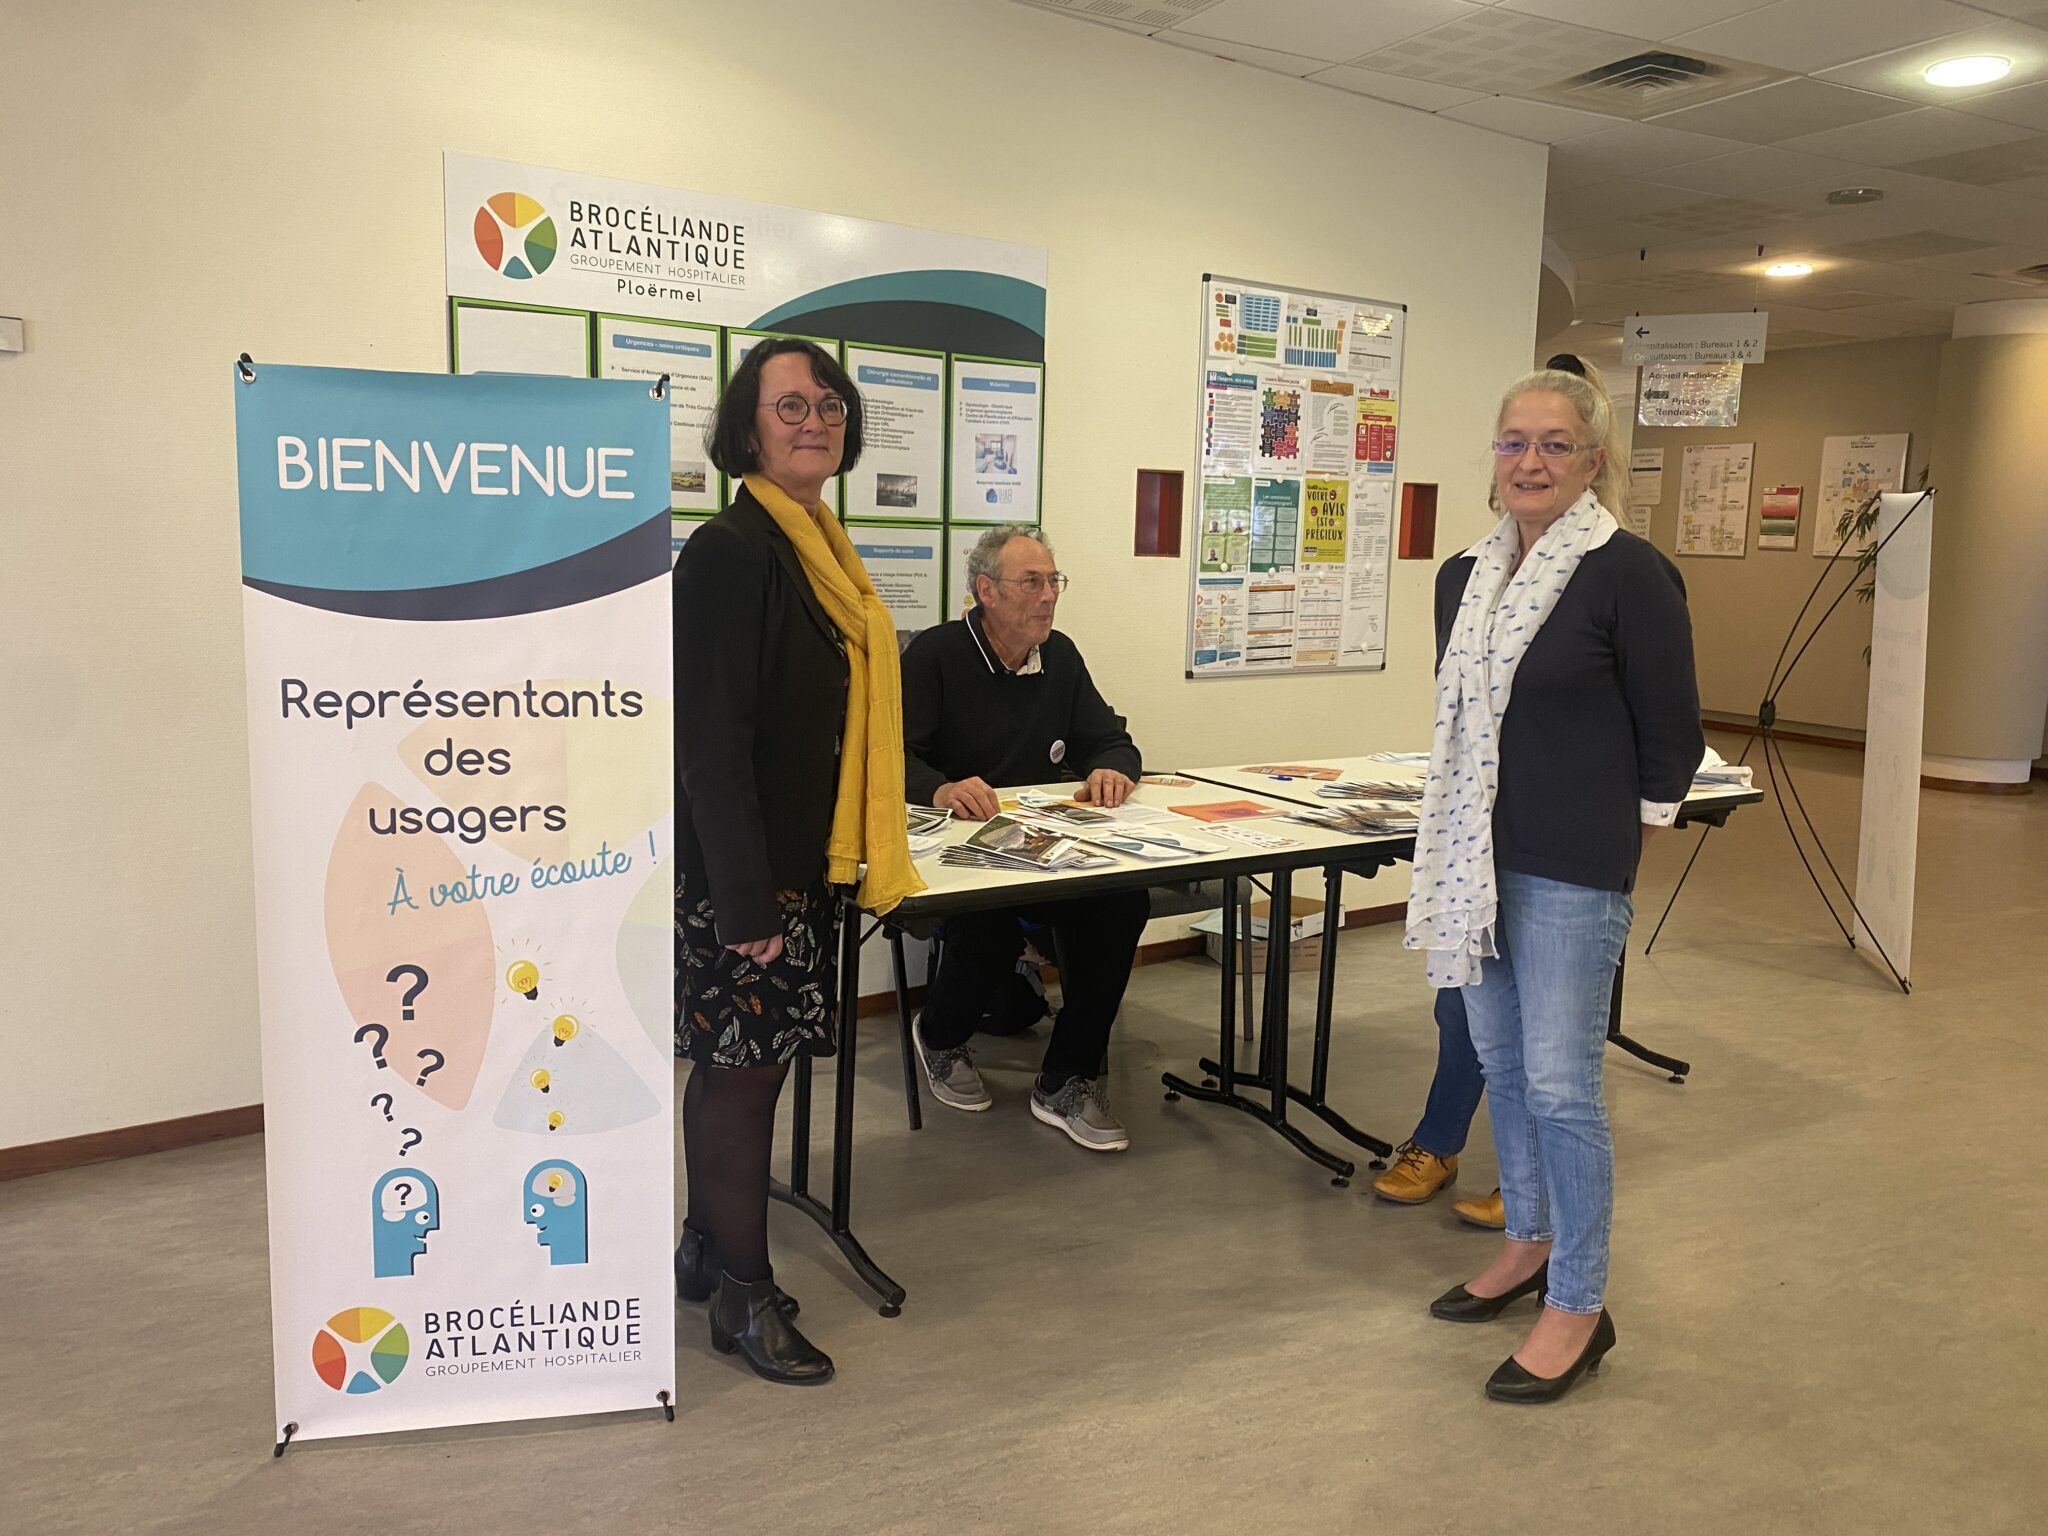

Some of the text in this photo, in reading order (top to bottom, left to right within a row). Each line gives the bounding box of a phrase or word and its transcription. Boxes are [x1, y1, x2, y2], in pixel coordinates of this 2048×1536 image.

[570, 201, 744, 246] BROCÉLIANDE
[570, 227, 745, 270] ATLANTIQUE
[570, 254, 746, 286] GROUPEMENT HOSPITALIER
[618, 278, 701, 302] Ploërmel
[625, 338, 654, 347] Urgences
[1695, 352, 1727, 360] Bureaux
[1700, 340, 1733, 349] Bureaux
[277, 436, 635, 500] BIENVENUE
[1307, 491, 1328, 501] VOTRE
[1323, 502, 1345, 516] AVIS
[1306, 526, 1343, 540] PRÉCIEUX
[1316, 516, 1328, 527] EST
[281, 678, 644, 730] Représentants
[424, 738, 512, 776] des
[368, 802, 566, 844] usagers
[387, 868, 418, 916] À
[430, 864, 520, 908] votre
[530, 841, 632, 890] écoute
[425, 1298, 641, 1334] BROCÉLIANDE
[426, 1324, 642, 1360] ATLANTIQUE
[426, 1350, 642, 1377] GROUPEMENT HOSPITALIER
